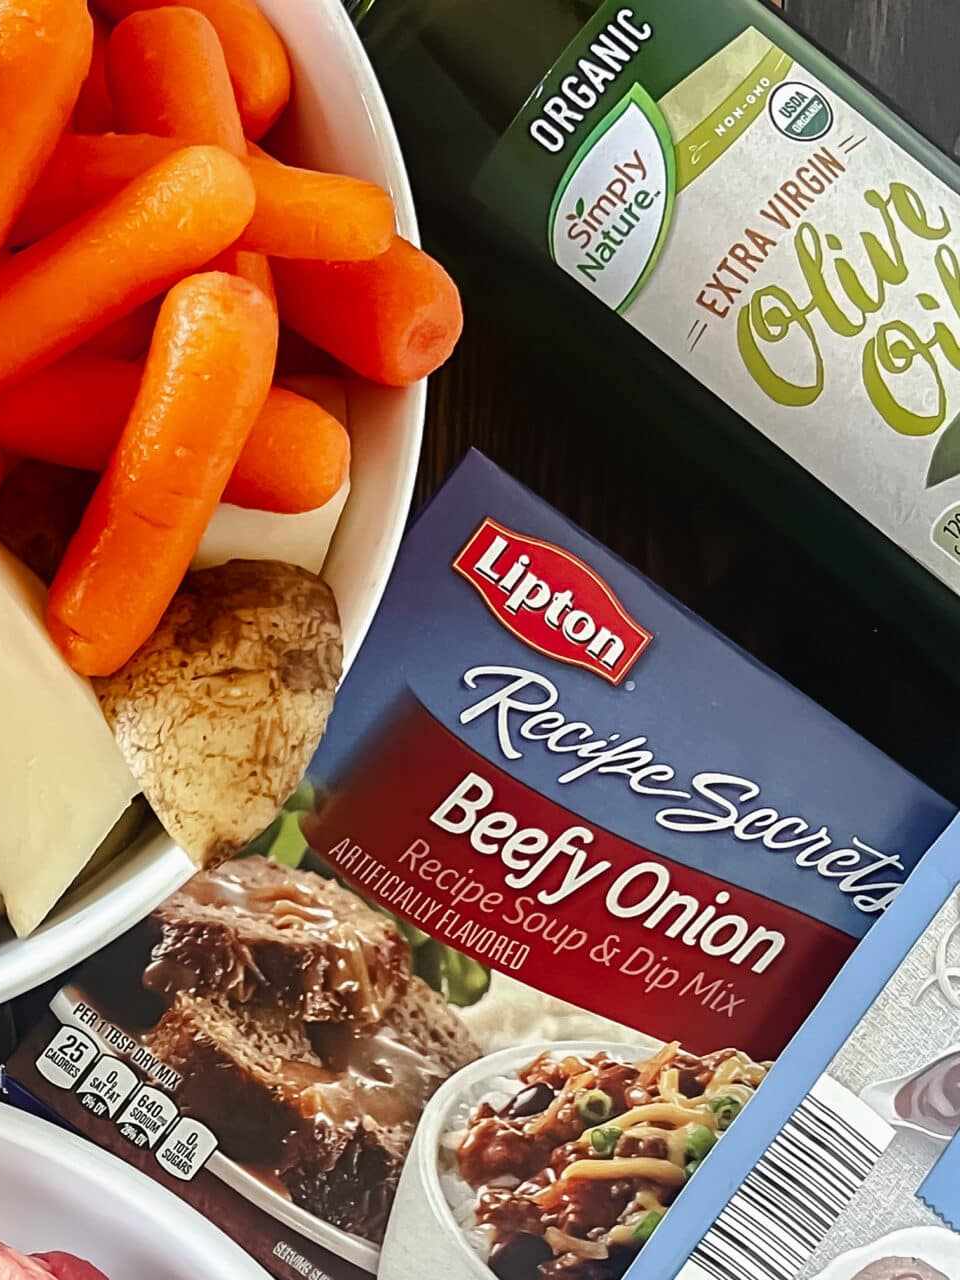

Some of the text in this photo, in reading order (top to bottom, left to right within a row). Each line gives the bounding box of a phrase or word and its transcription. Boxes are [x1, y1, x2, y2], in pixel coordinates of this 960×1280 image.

[530, 8, 652, 153] ORGANIC
[714, 77, 771, 137] NON-GMO
[778, 91, 809, 119] USDA
[791, 100, 824, 133] ORGANIC
[566, 149, 649, 250] Simply
[695, 146, 846, 318] EXTRA VIRGIN
[737, 182, 952, 407] Olive
[472, 535, 626, 670] Lipton
[459, 665, 906, 913] Recipe Secrets
[328, 837, 531, 971] ARTIFICIALLY FLAVORED
[428, 772, 786, 974] Beefy Onion
[398, 838, 745, 1018] Recipe Soup & Dip Mix
[44, 1047, 81, 1078] CALORIES
[58, 1034, 89, 1063] 25
[72, 1002, 182, 1090] PER 1 TBSP DRY MIX
[89, 1077, 121, 1104] SAT FAT
[129, 1106, 161, 1134] SODIUM
[161, 1148, 193, 1175] SUGARS
[173, 1140, 196, 1163] TOTAL
[272, 1241, 313, 1277] SERVING
